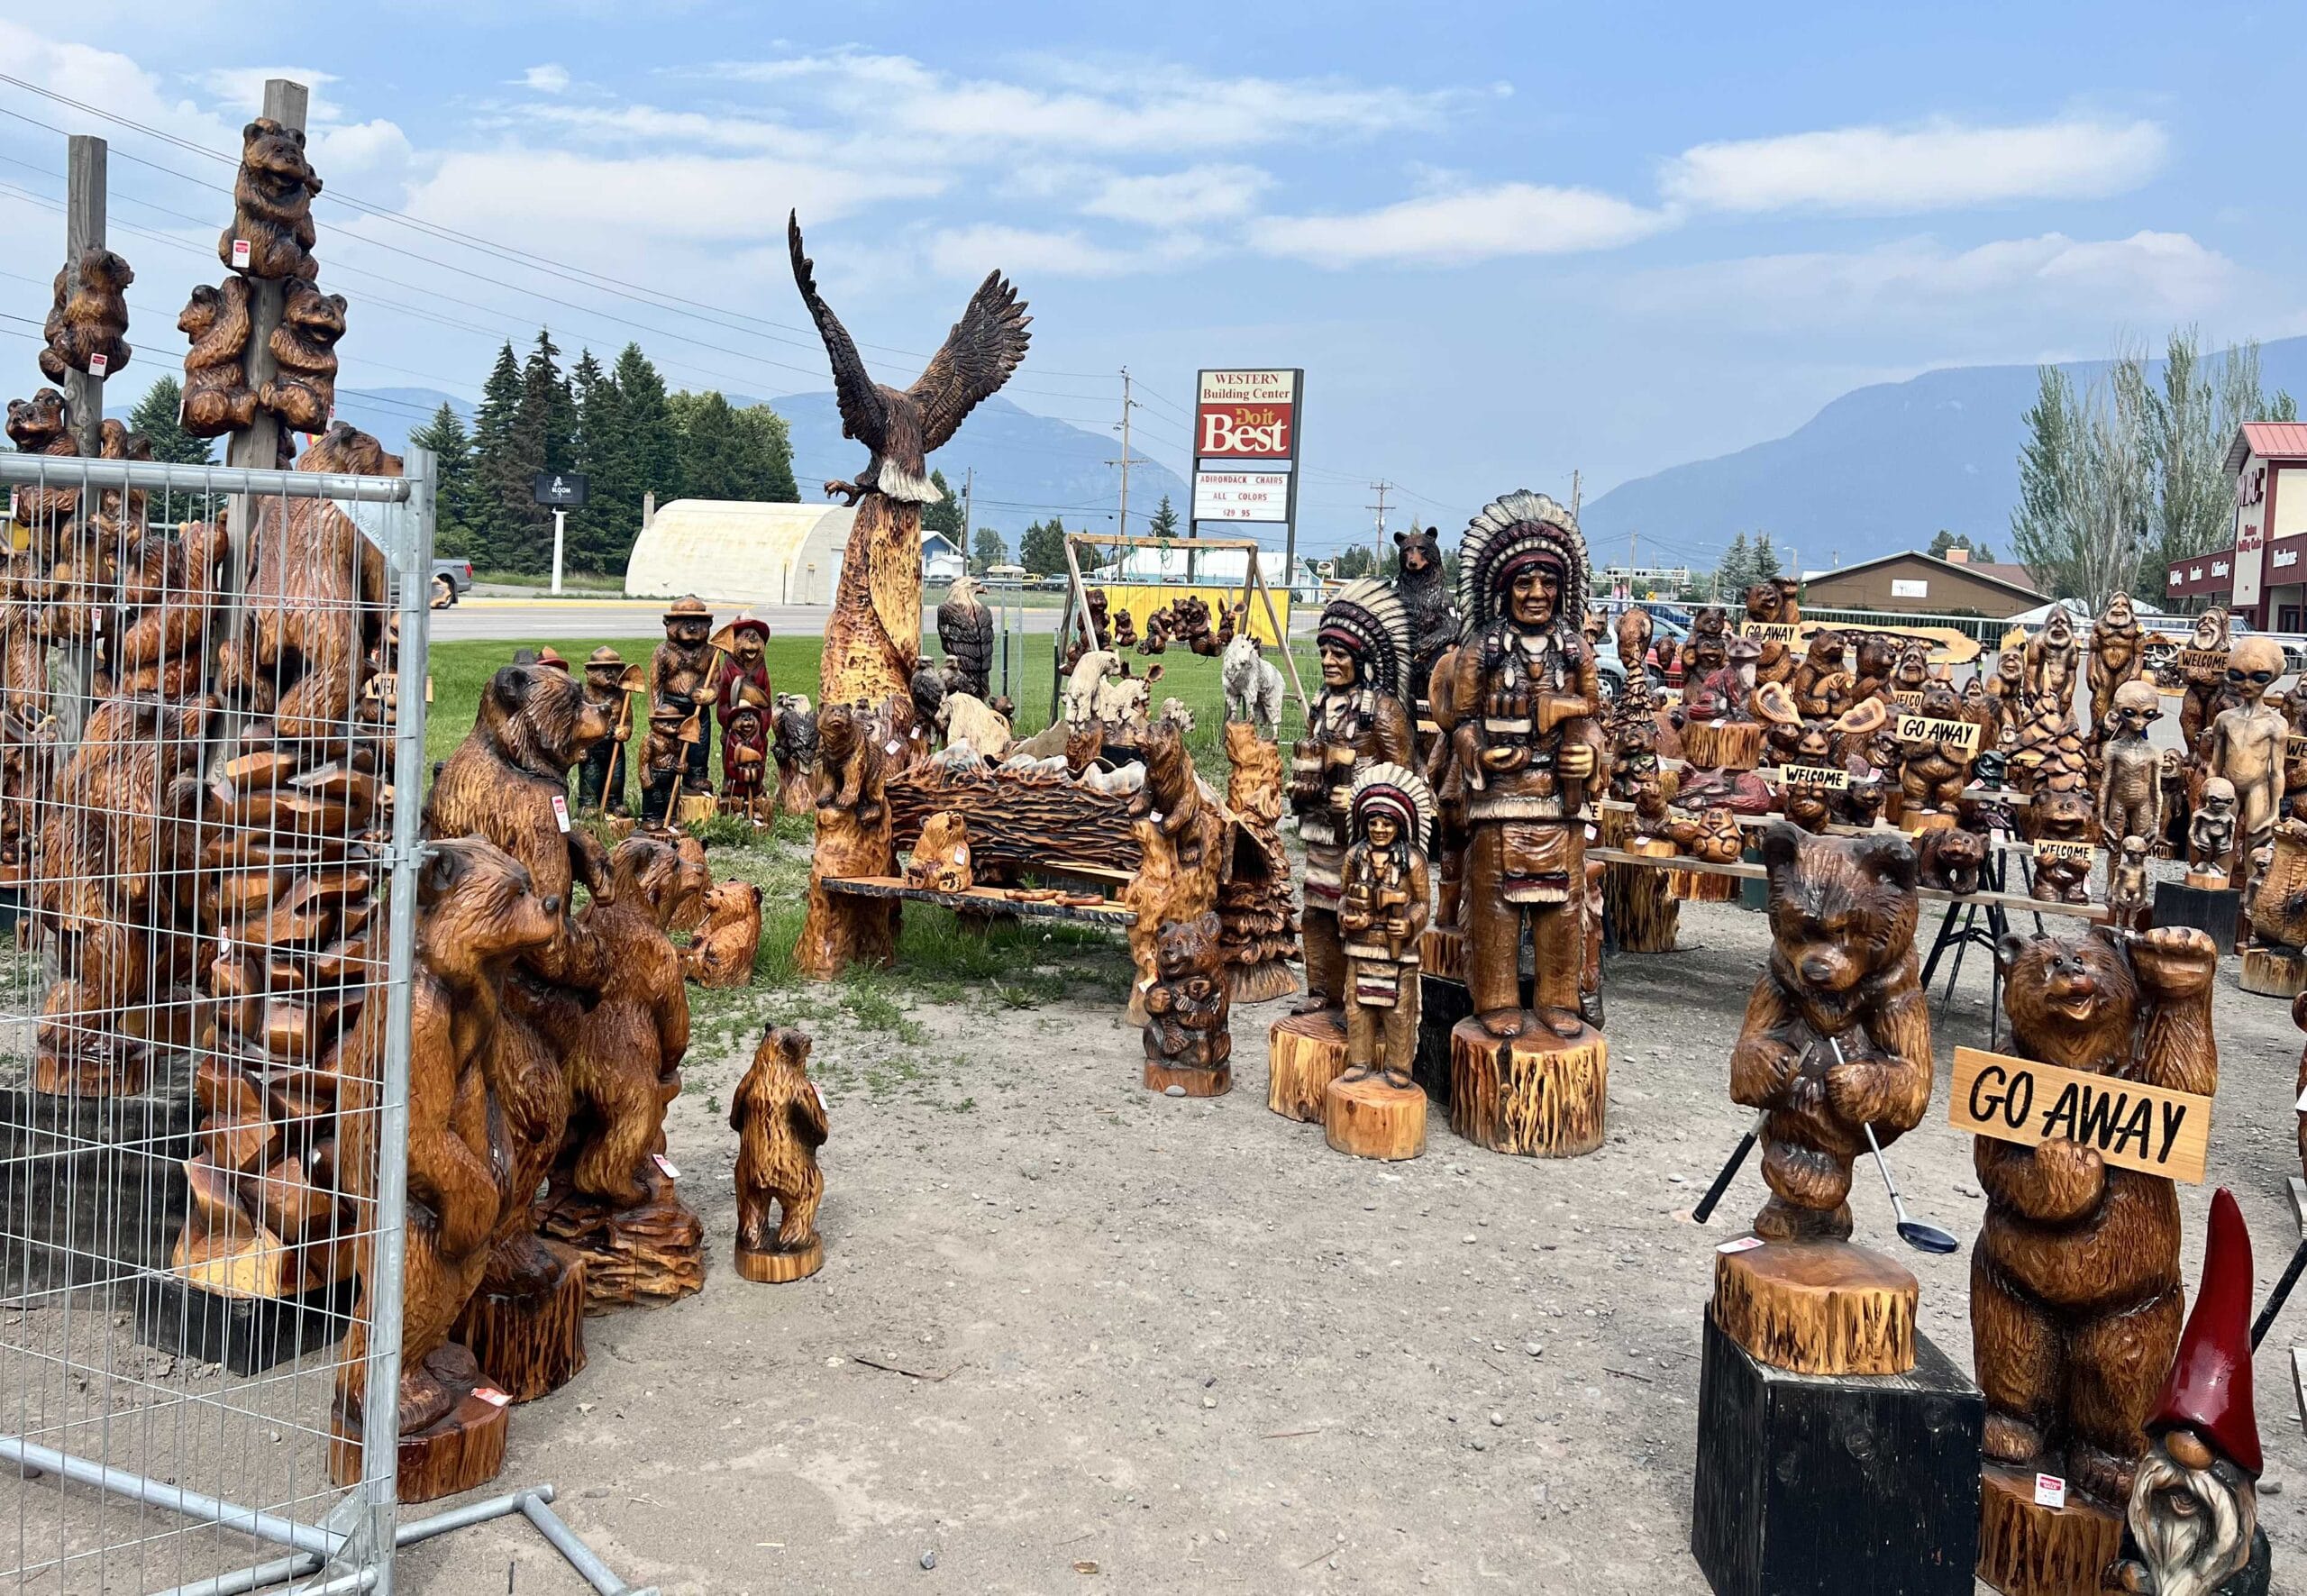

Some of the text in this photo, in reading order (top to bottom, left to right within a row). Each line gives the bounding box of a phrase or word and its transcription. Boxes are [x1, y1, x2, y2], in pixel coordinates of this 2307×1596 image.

[1216, 374, 1279, 385] WESTERN
[1203, 388, 1290, 401] Building Center
[1200, 414, 1288, 452] Best
[1200, 475, 1283, 484] ADIRONDACK CHAIRS
[1213, 492, 1268, 501] ALL COLORS
[1241, 509, 1251, 517] 95
[1763, 626, 1795, 642] AWAY
[2182, 652, 2229, 670] WELCOME
[1903, 719, 1974, 744] GO AWAY
[1786, 766, 1844, 787] WELCOME
[2038, 843, 2090, 859] WELCOME
[1968, 1065, 2187, 1164] GO AWAY
